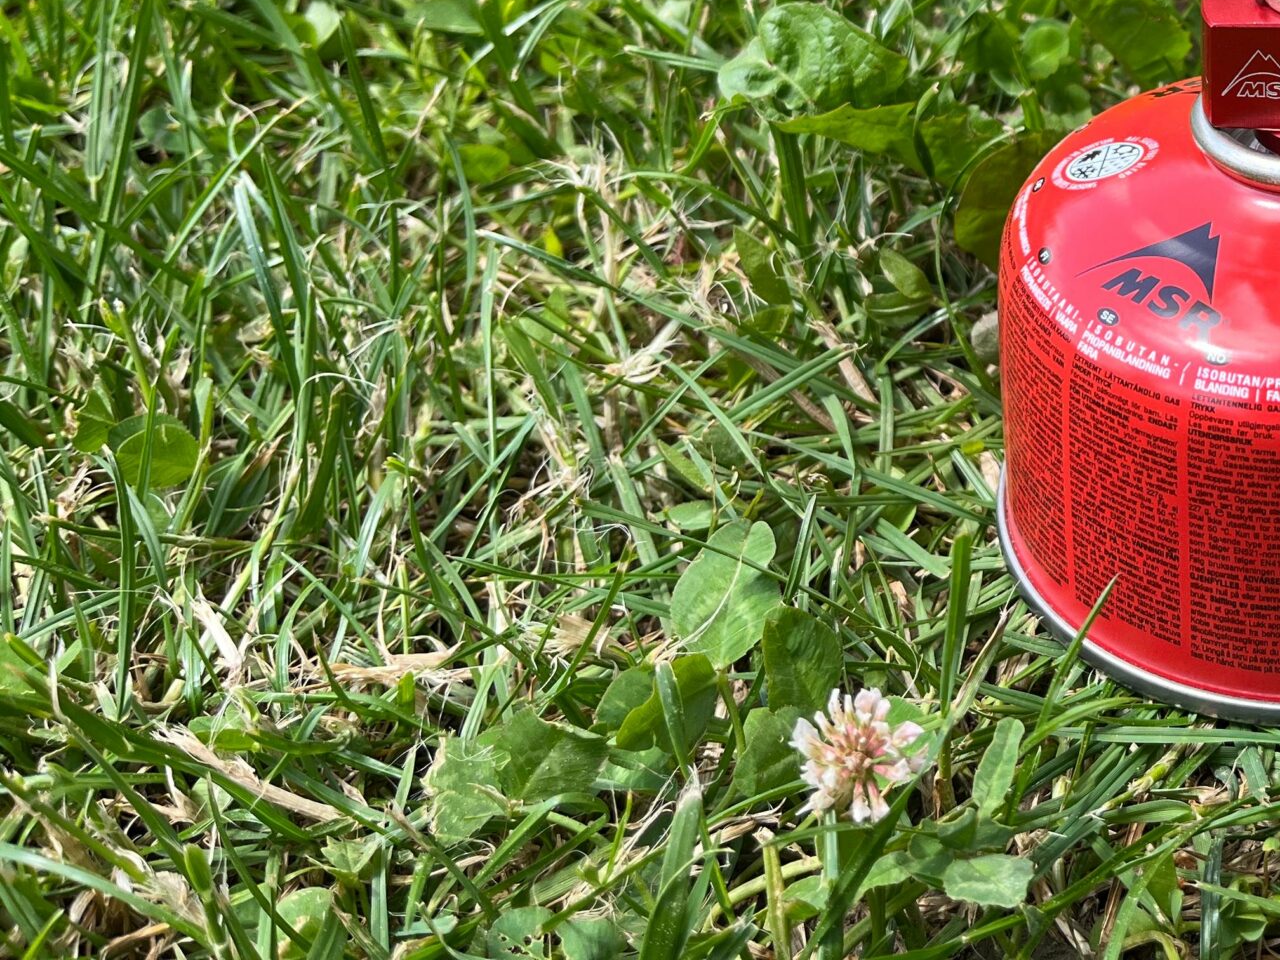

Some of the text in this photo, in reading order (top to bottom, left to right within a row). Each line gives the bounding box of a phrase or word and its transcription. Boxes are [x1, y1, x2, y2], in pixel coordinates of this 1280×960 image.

[1101, 267, 1222, 343] MSR
[1100, 310, 1116, 325] SE
[1077, 341, 1099, 361] FARA
[1082, 330, 1171, 380] PROPANBLANDNING
[1206, 350, 1227, 364] NO
[1093, 373, 1112, 389] TRYCK
[1194, 379, 1250, 399] BLANDING
[1164, 396, 1181, 406] GAS
[1190, 402, 1215, 414] TRYKK
